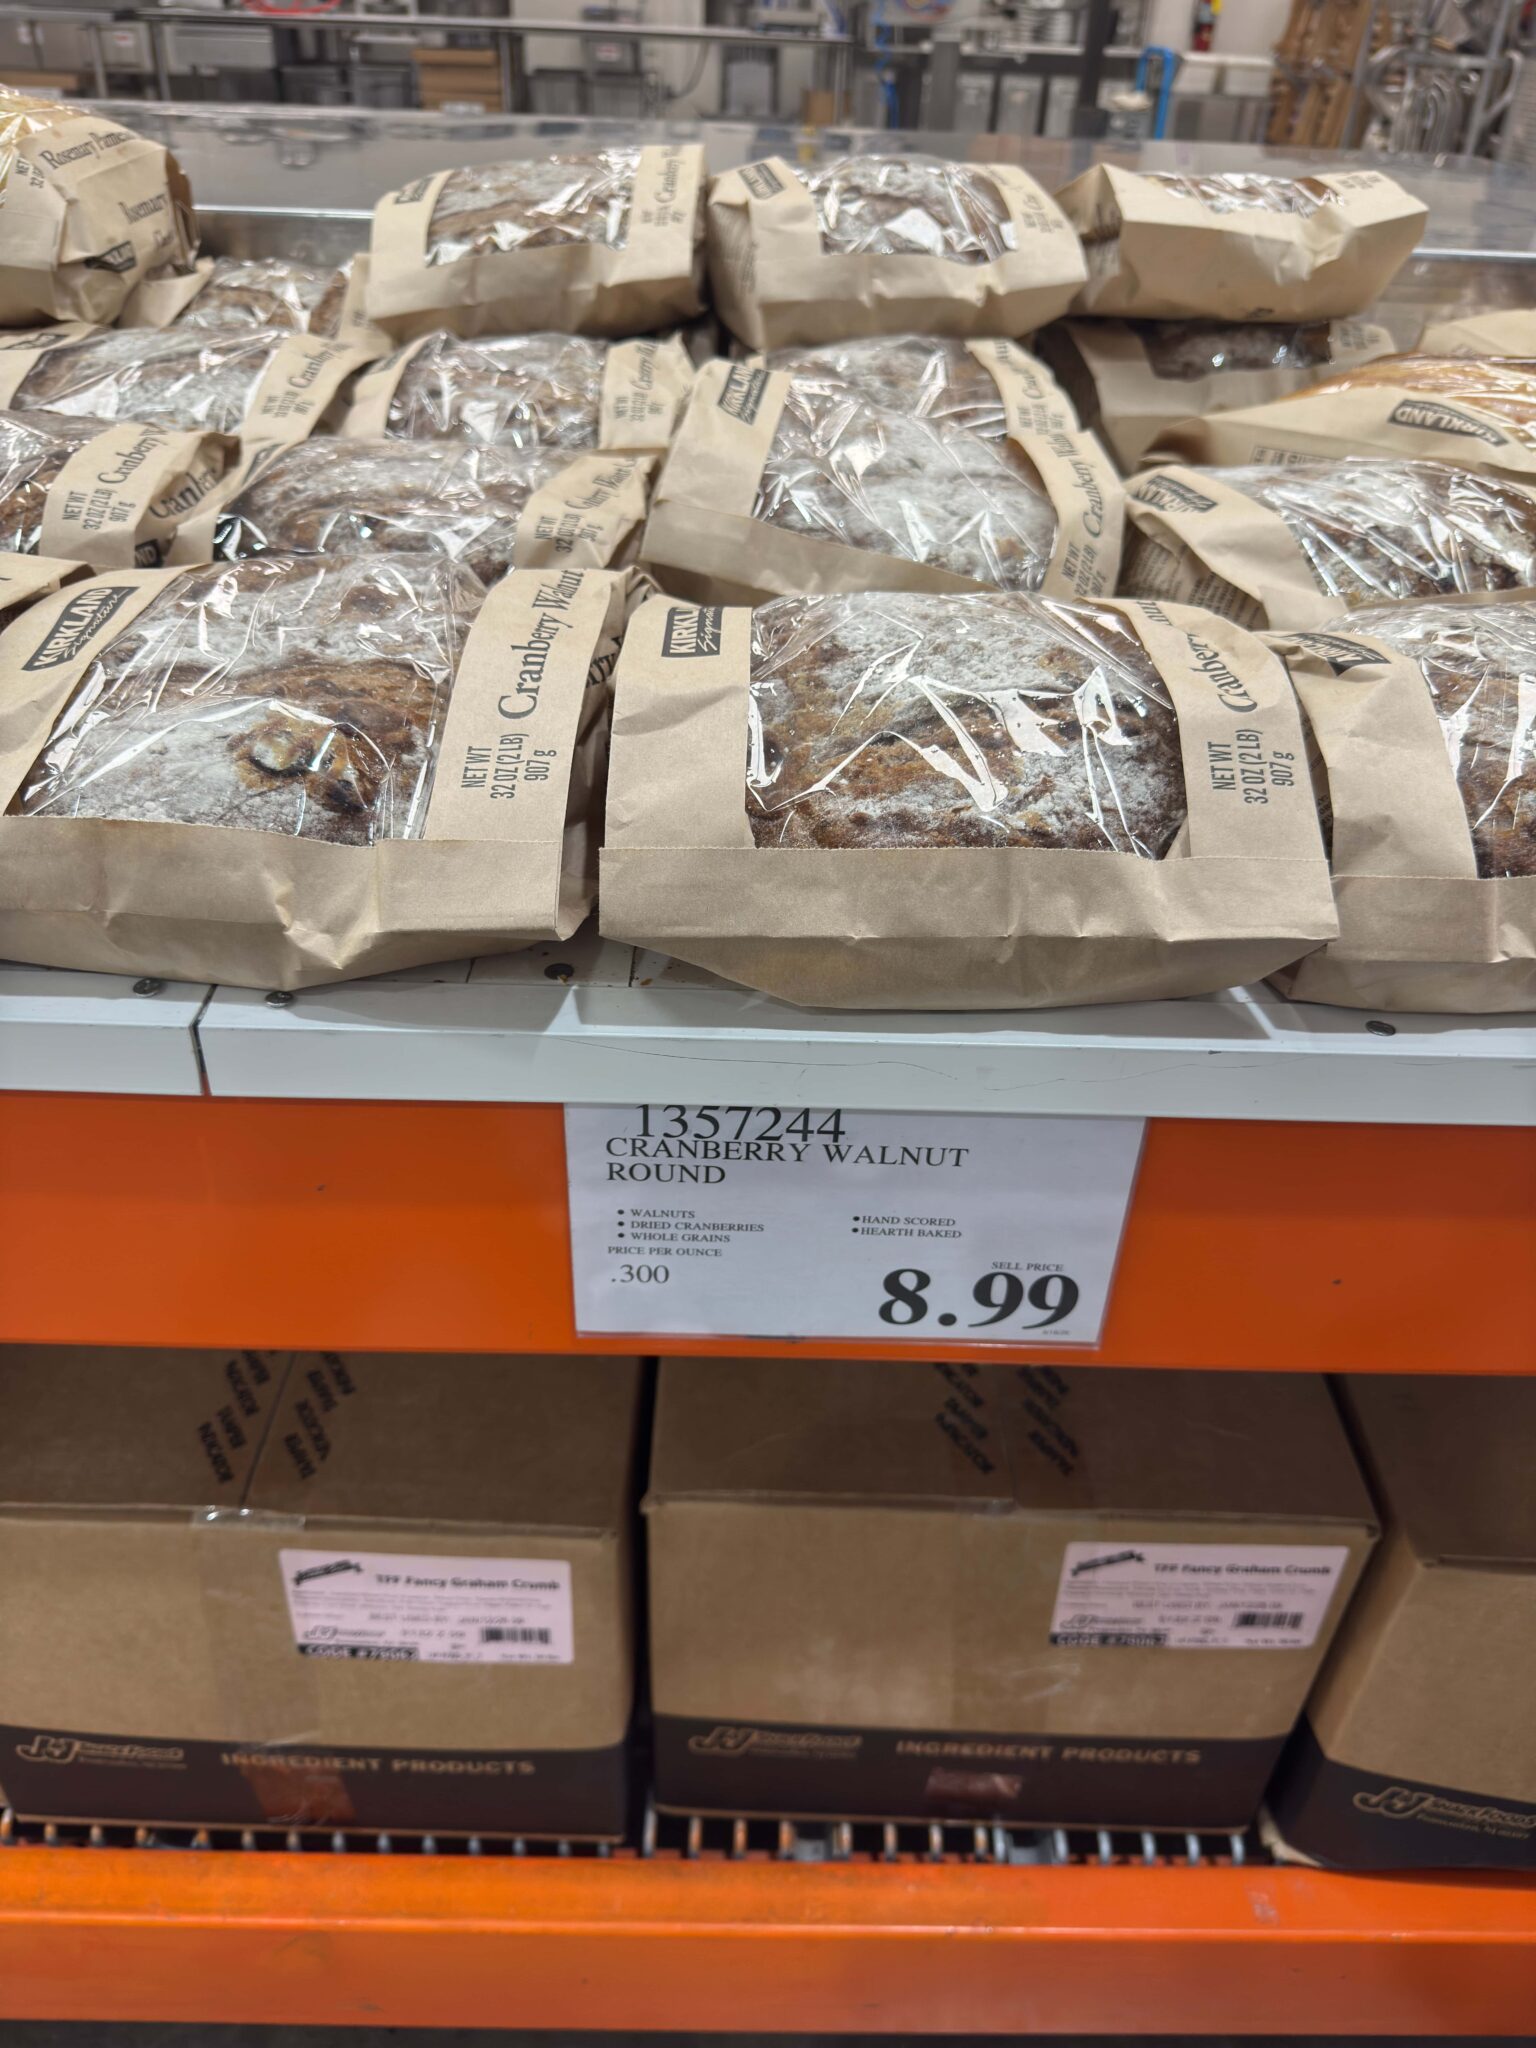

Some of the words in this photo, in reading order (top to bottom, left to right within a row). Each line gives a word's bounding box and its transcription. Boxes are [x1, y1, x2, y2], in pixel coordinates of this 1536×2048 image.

[97, 435, 170, 484] Cranberry
[531, 568, 586, 612] Walnut
[33, 586, 115, 668] KIRKLAND
[668, 608, 700, 655] KIRKL
[497, 612, 574, 720] Cranberry
[498, 732, 530, 752] LB)
[1234, 728, 1264, 750] LB)
[465, 745, 493, 764] WT
[495, 754, 526, 765] (2
[533, 749, 558, 758] g
[1206, 741, 1234, 763] WT
[1238, 752, 1268, 765] (2
[1272, 750, 1296, 761] g
[460, 766, 489, 788] NET
[492, 767, 519, 782] OZ
[523, 759, 551, 781] 907
[1209, 764, 1237, 791] NET
[1239, 768, 1266, 785] OZ
[1268, 761, 1295, 787] 907
[489, 783, 517, 800] 32
[1243, 787, 1269, 805] 32
[634, 1103, 846, 1144] 1357244
[605, 1137, 812, 1162] CRANBERRY
[822, 1143, 970, 1168] WALNUT
[606, 1161, 727, 1185] ROUND
[630, 1208, 696, 1219] WALNUTS
[862, 1215, 901, 1226] HAND
[903, 1216, 956, 1228] SCORED
[630, 1220, 671, 1231] DRIED
[674, 1221, 765, 1233] CRANBERRIES
[861, 1226, 914, 1238] HEARTH
[917, 1228, 963, 1240] BAKED
[630, 1231, 679, 1243] WHOLE
[680, 1232, 731, 1244] GRAINS
[607, 1245, 646, 1256] PRICE
[649, 1246, 674, 1257] PER
[675, 1246, 723, 1258] OUNCE
[611, 1263, 671, 1285] .300
[991, 1261, 1023, 1272] SELL
[1026, 1262, 1065, 1273] PRICE
[878, 1268, 1080, 1330] 8.99
[1181, 1562, 1223, 1577] Fancy
[1224, 1562, 1282, 1576] Graham
[1284, 1563, 1333, 1577] Crumb
[405, 1573, 449, 1590] Fancy
[450, 1576, 509, 1590] Graham
[511, 1577, 561, 1591] Crumb
[894, 1738, 1053, 1764] INGREDIENT
[1060, 1743, 1204, 1766] PRODUCTS
[219, 1752, 382, 1773] INGREDIENT
[391, 1758, 536, 1776] PRODUCTS
